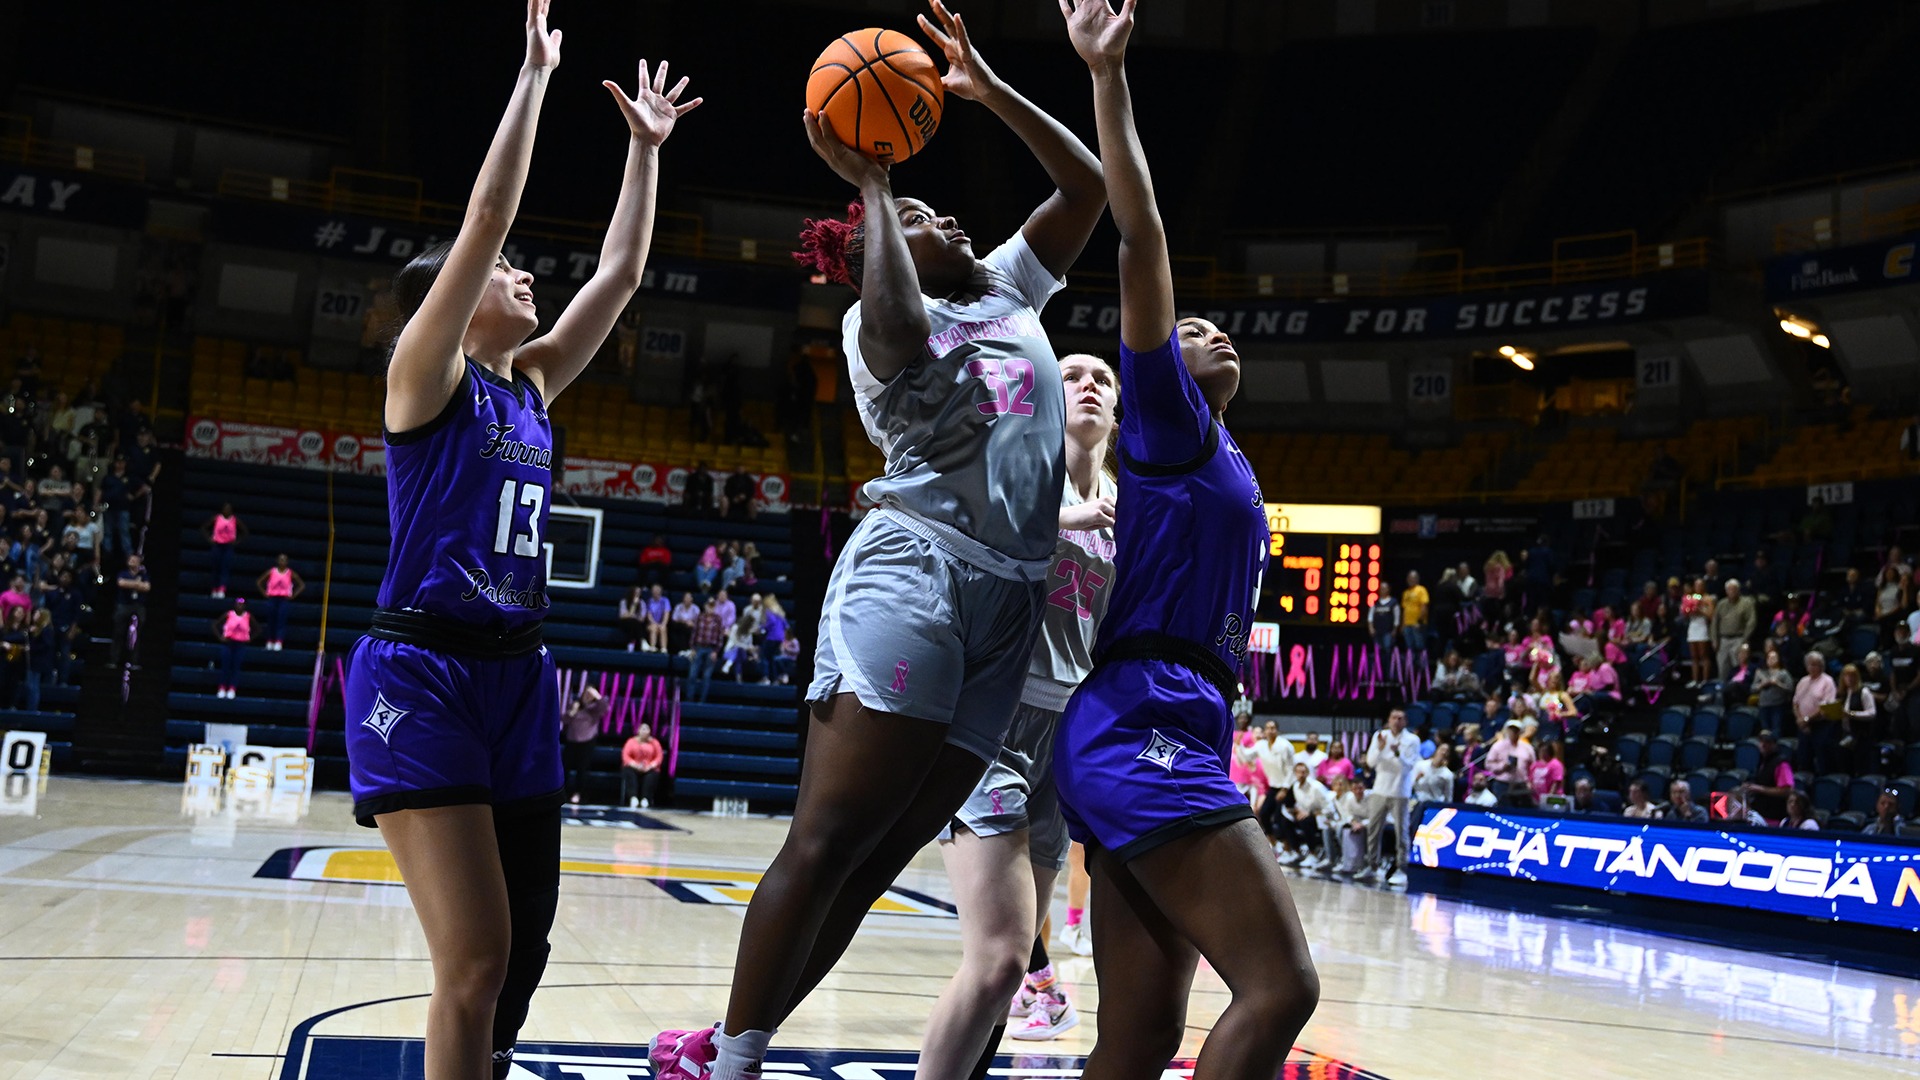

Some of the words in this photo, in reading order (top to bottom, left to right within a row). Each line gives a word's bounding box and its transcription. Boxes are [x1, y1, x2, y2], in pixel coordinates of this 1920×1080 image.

[321, 292, 361, 317] 207
[1344, 308, 1428, 335] FOR
[1455, 288, 1648, 330] SUCCESS
[645, 331, 682, 353] 208
[966, 357, 1035, 417] 32
[1414, 375, 1446, 397] 210
[1643, 361, 1670, 384] 211
[479, 422, 552, 471] Furma
[494, 479, 545, 559] 13
[1048, 558, 1106, 621] 25
[1305, 567, 1321, 591] 0
[1247, 628, 1274, 650] XIT
[1455, 825, 1879, 905] CHATTANOOGA
